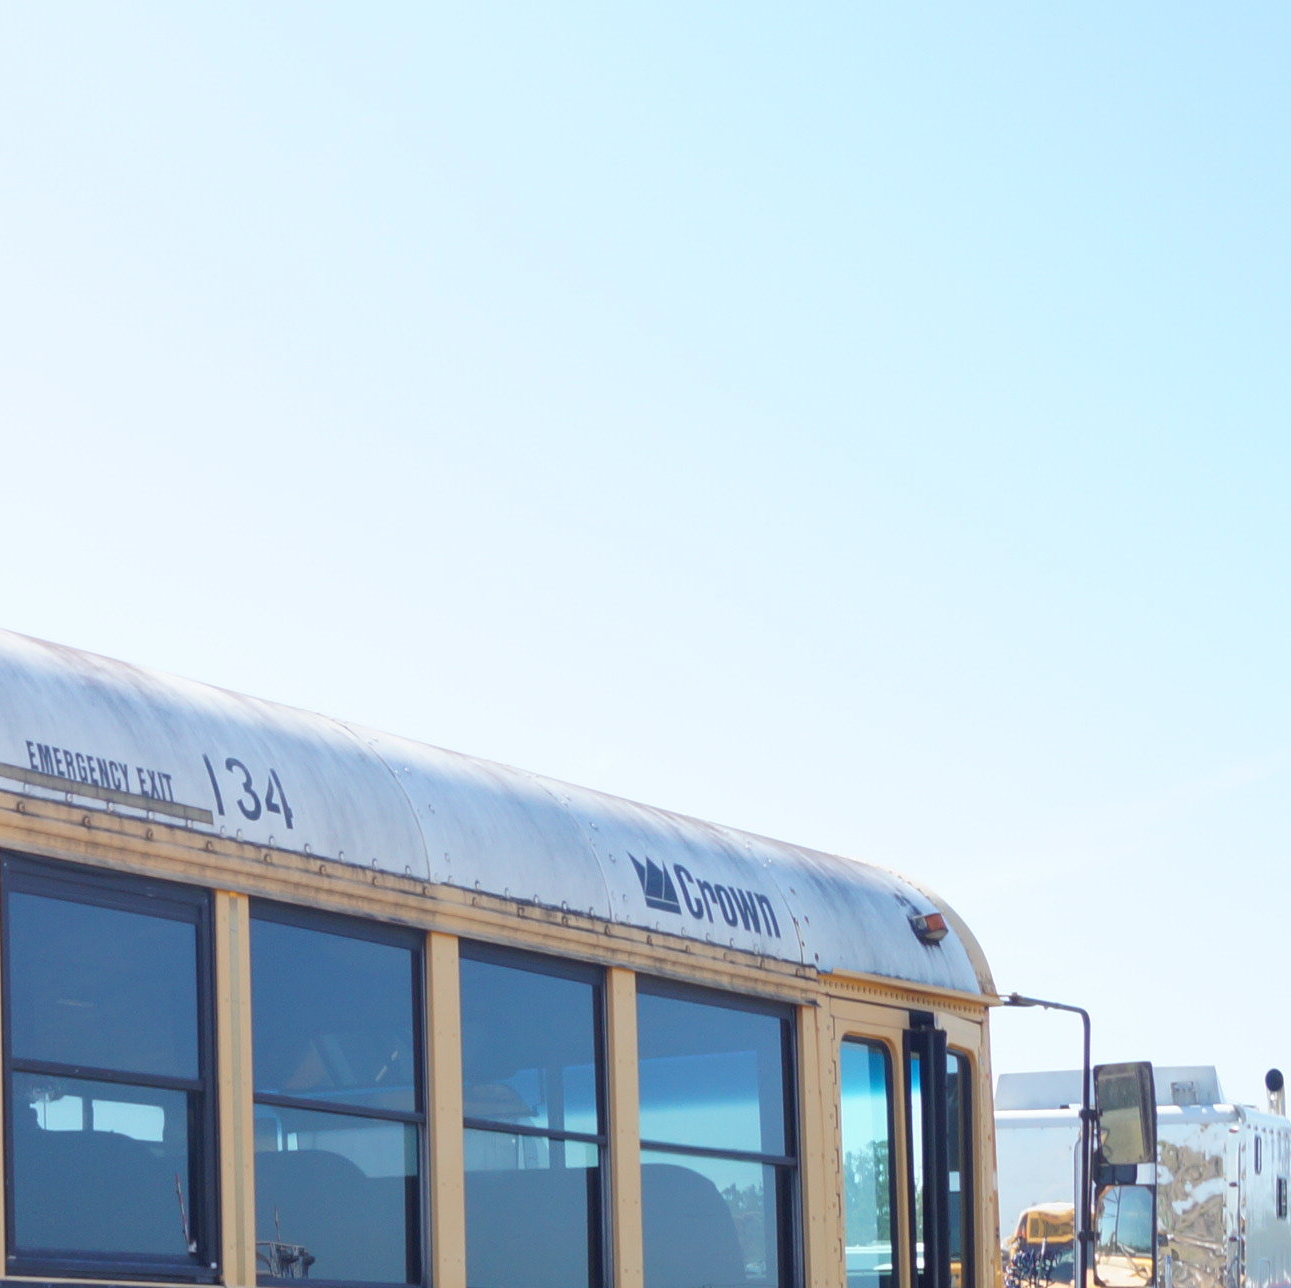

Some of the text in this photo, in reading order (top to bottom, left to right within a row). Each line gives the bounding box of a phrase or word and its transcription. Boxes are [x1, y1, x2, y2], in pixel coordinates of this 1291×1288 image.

[26, 740, 173, 802] EMERGENCY EXIT
[202, 753, 294, 830] 134
[673, 863, 781, 938] Crown
